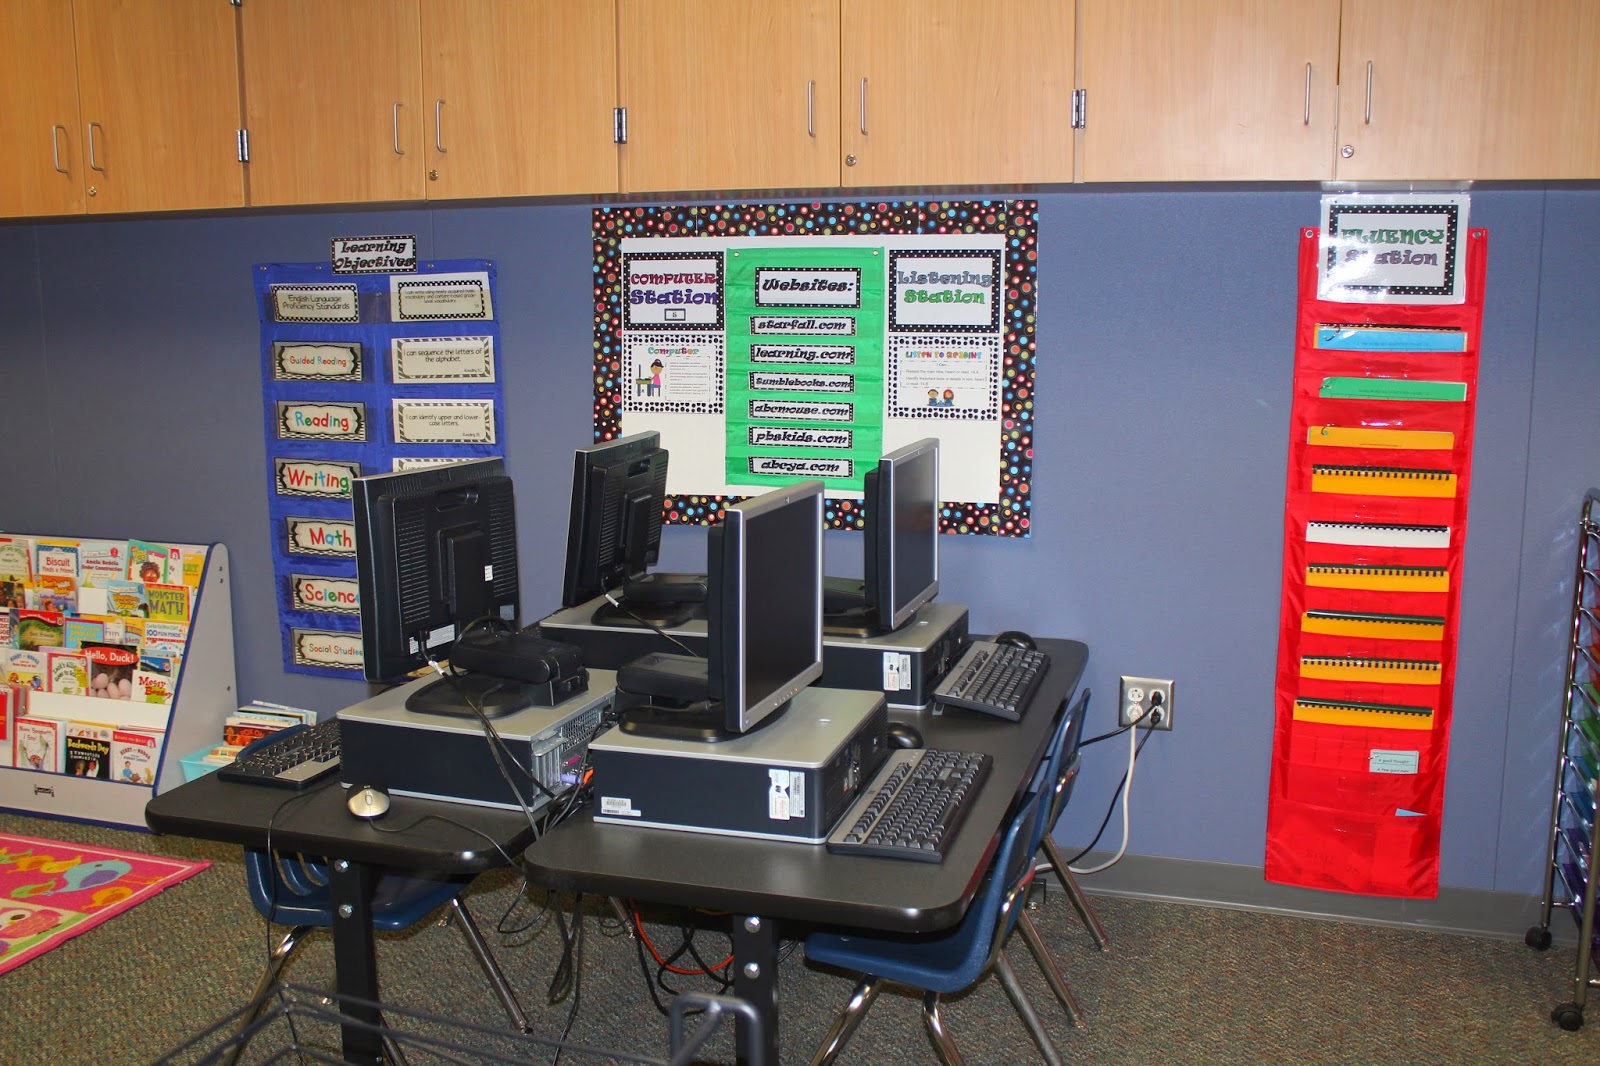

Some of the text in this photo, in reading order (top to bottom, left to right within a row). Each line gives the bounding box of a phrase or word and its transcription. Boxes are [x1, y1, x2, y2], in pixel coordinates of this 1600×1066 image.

[341, 240, 407, 254] Learning
[335, 256, 414, 270] Objectives
[1345, 249, 1438, 266] Sation
[762, 278, 854, 292] Websites:
[897, 270, 993, 288] Listening
[288, 294, 342, 304] English Language
[630, 288, 718, 305] Station
[904, 289, 986, 304] Station
[282, 302, 315, 311] Proficiency
[758, 319, 846, 330] starfall.com
[648, 346, 699, 356] Computer
[756, 348, 852, 361] learning.com
[290, 356, 346, 367] Guided Reading
[756, 377, 852, 388] tumblebooks.com
[754, 404, 848, 416] abcmouse.com
[294, 411, 349, 432] Reading
[756, 430, 847, 444] pbskids.com
[761, 460, 840, 472] abcya.com
[287, 466, 349, 493] Writing
[309, 527, 352, 548] Math
[46, 557, 70, 566] Biscuit
[148, 590, 185, 601] MONSTER
[149, 600, 184, 615] MATH
[309, 644, 331, 653] Social
[85, 650, 134, 662] Hello, Duck!
[139, 676, 166, 689] Messy
[67, 738, 109, 755] Backwards Day
